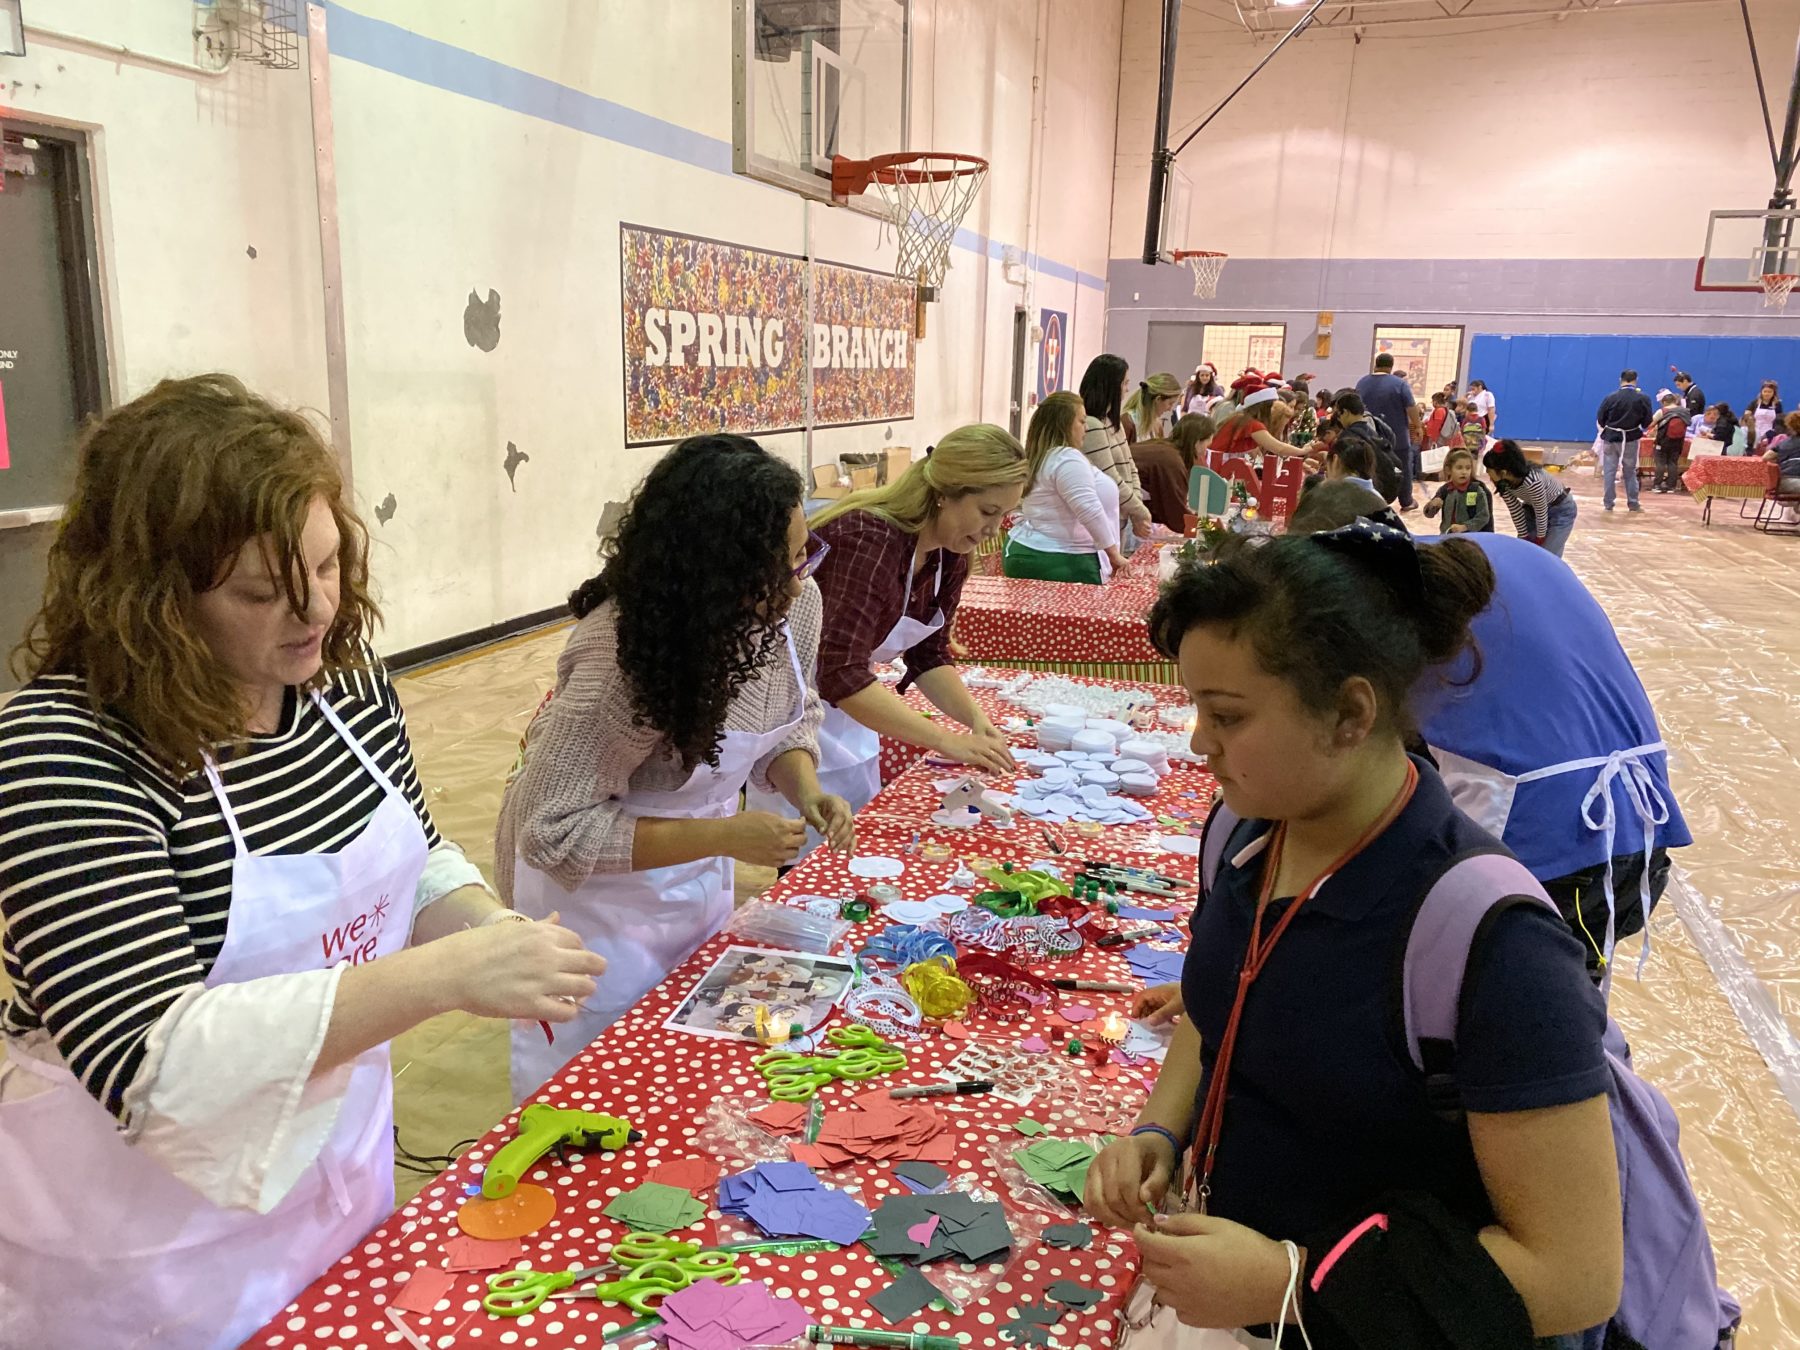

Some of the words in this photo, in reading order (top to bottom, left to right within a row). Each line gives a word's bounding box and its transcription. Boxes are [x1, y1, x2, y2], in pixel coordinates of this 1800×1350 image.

[644, 307, 784, 368] SPRING
[812, 322, 908, 369] BRANCH
[322, 914, 366, 958] we
[325, 936, 377, 968] re
